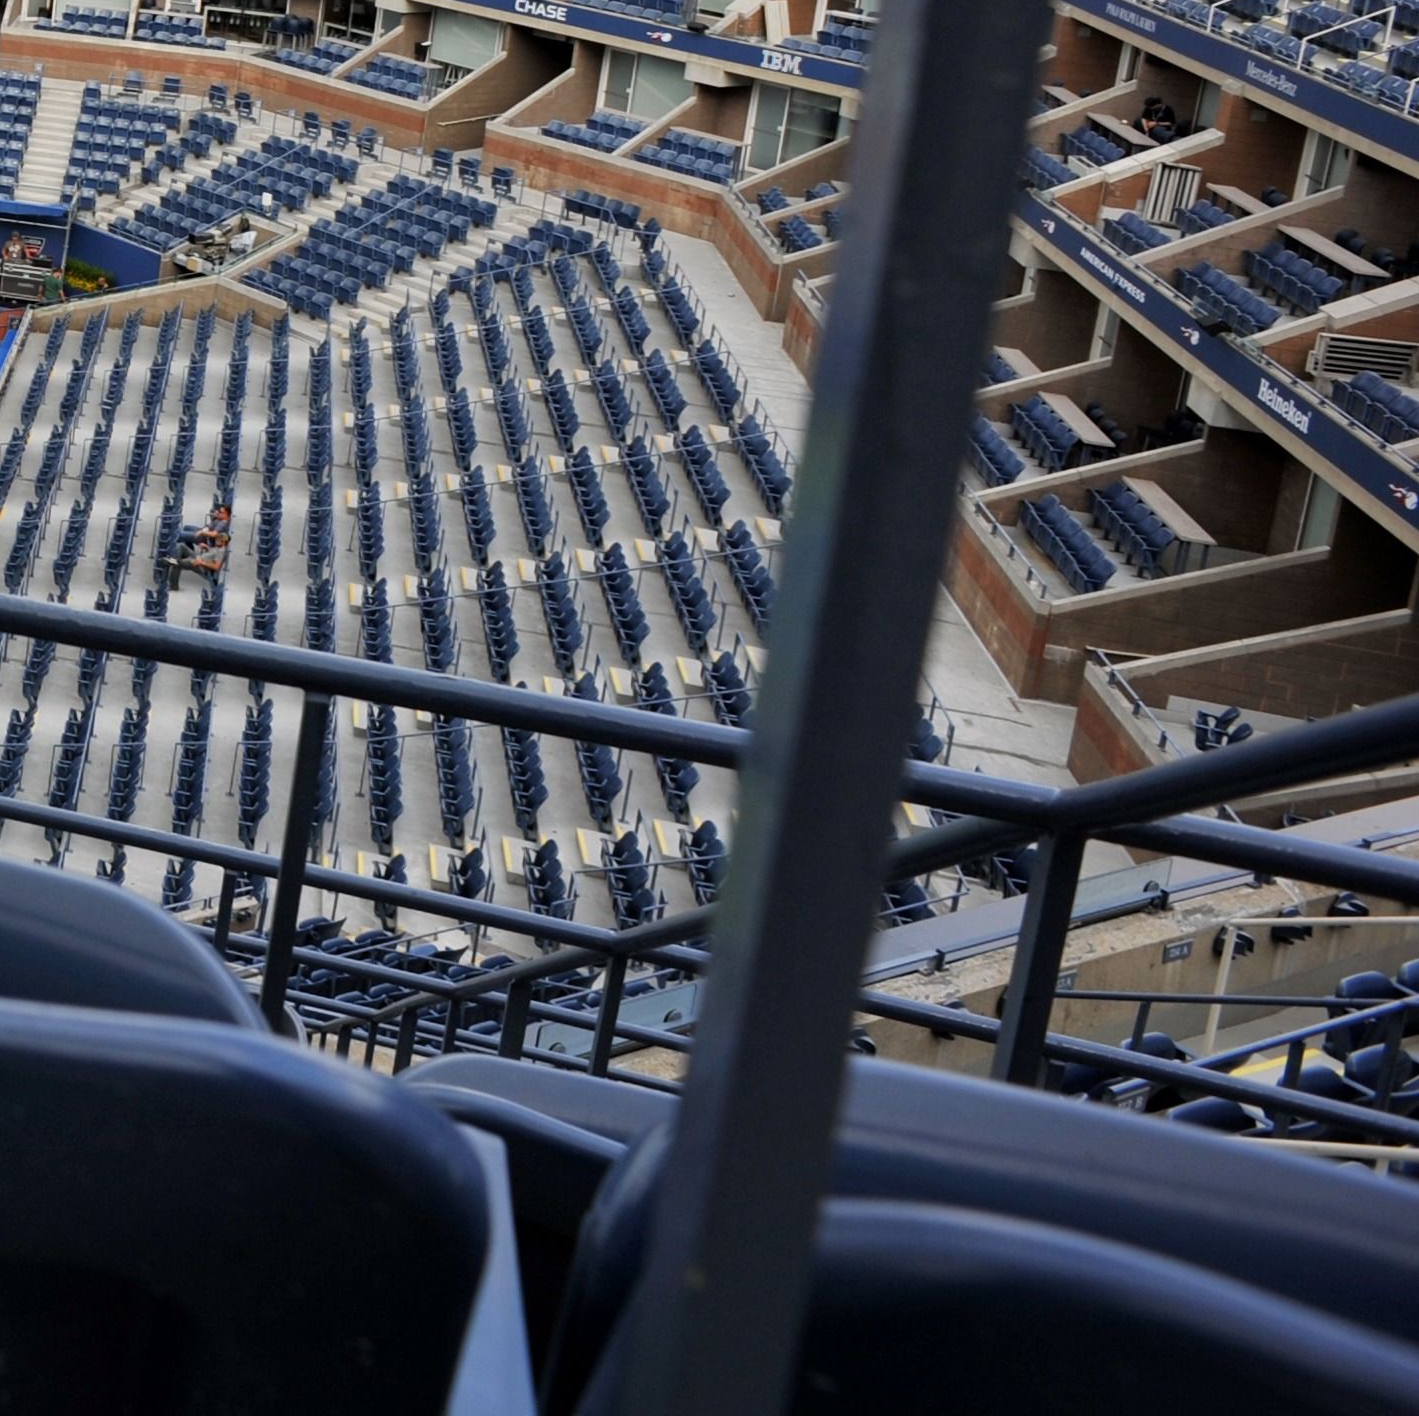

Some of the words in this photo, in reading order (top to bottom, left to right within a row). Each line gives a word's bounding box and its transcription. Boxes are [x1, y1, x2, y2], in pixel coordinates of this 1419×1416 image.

[760, 49, 803, 76] IBM
[1245, 59, 1298, 98] Mercedes-Benz
[1080, 246, 1116, 281] AMERICAN
[1258, 377, 1312, 434] Heineken
